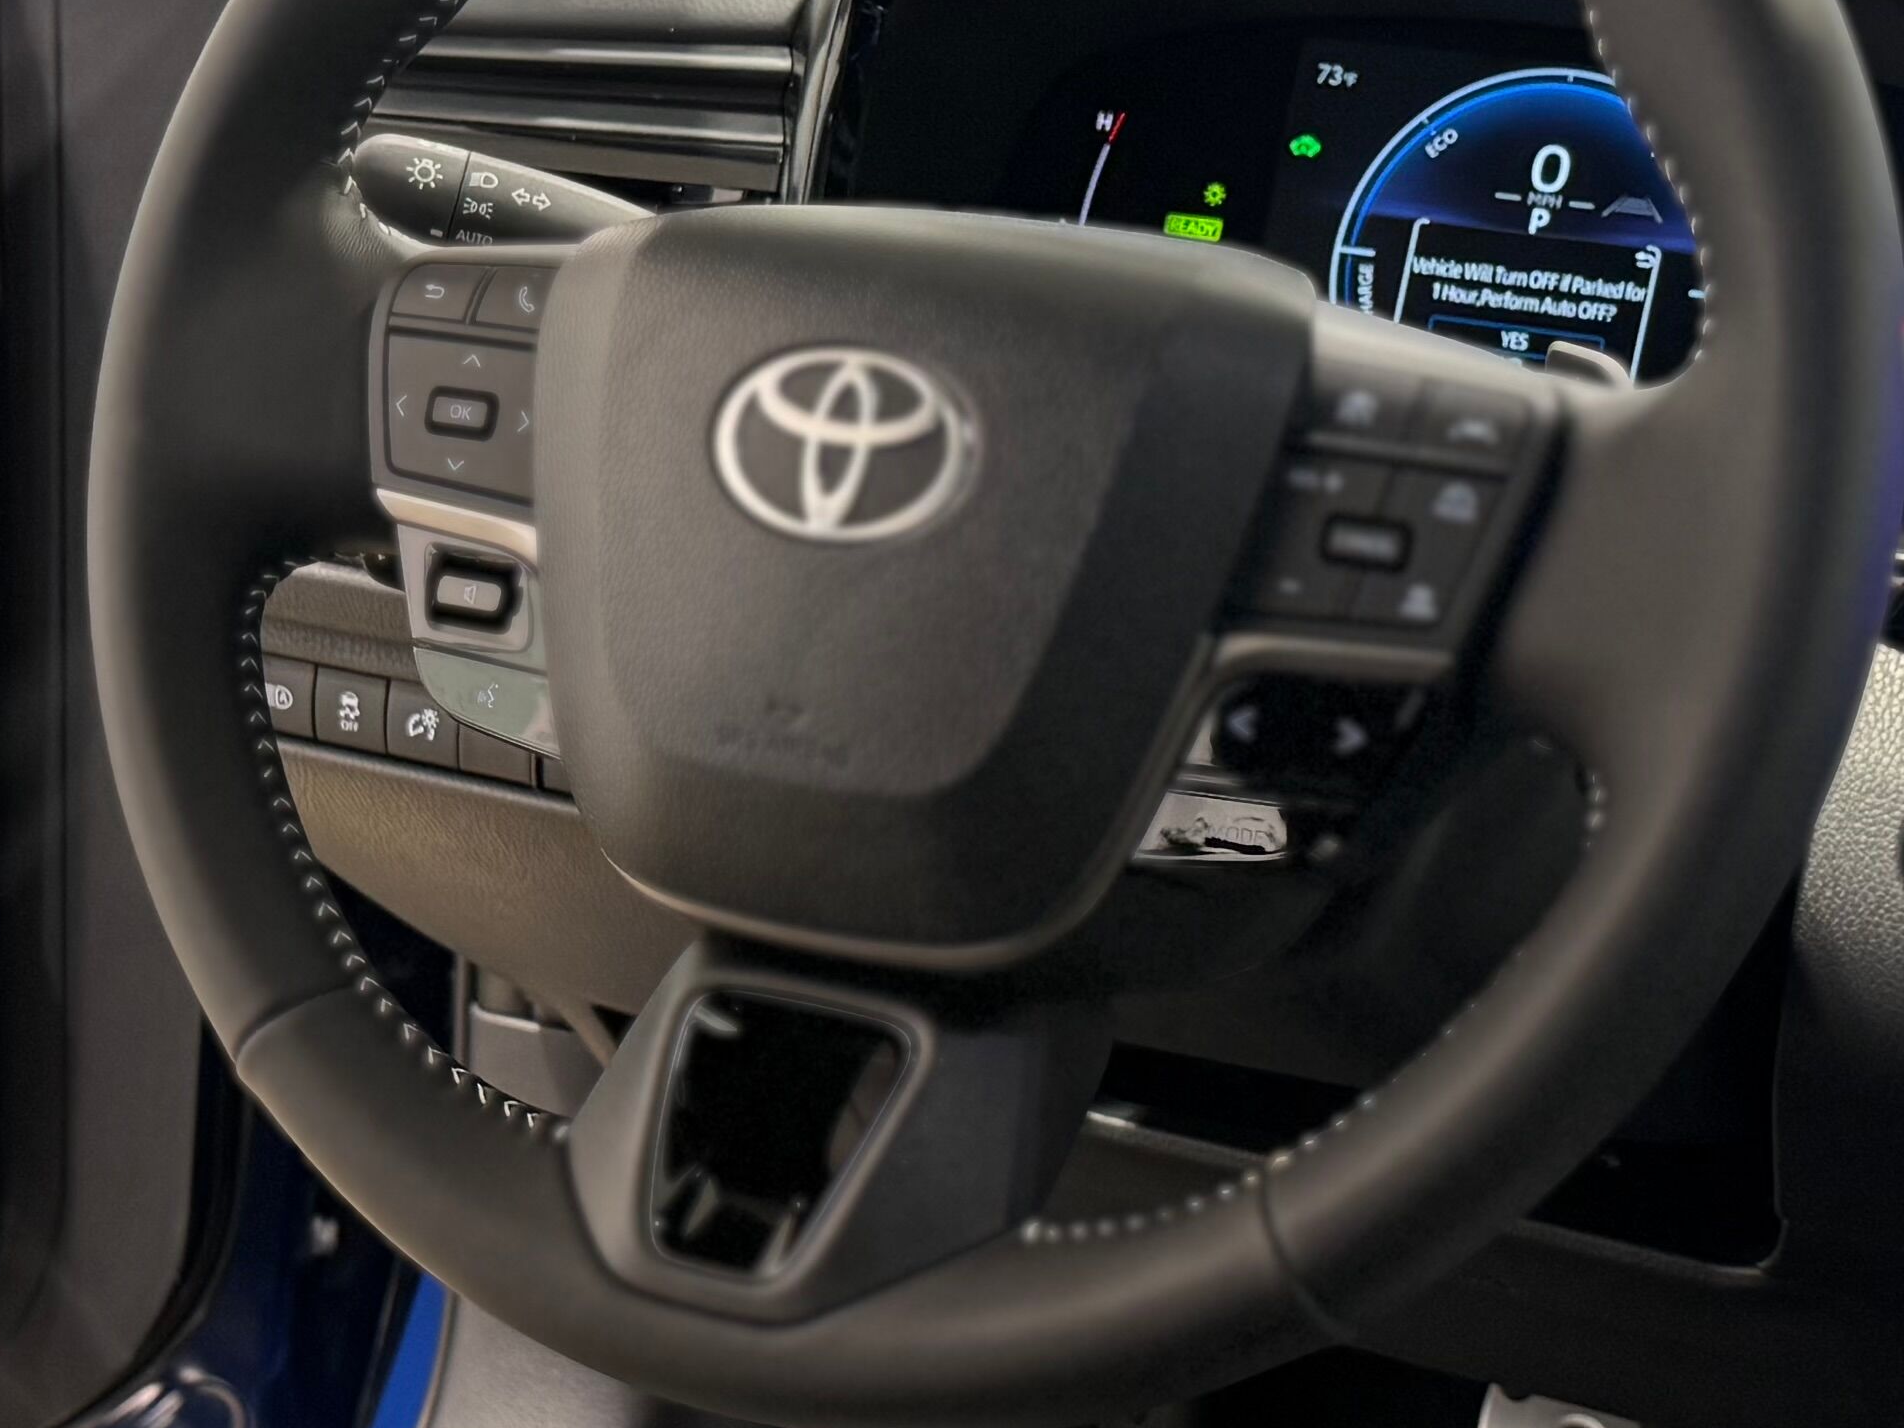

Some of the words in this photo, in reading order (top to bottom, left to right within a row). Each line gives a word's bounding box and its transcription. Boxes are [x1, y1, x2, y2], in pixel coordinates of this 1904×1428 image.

[1096, 110, 1114, 132] H
[1424, 128, 1459, 159] ECO
[1530, 144, 1571, 194] 0
[1170, 215, 1219, 239] READY
[1528, 207, 1551, 236] P
[455, 228, 494, 246] AUTO
[1412, 255, 1464, 281] Vehicle
[1464, 261, 1494, 283] Will
[1495, 266, 1528, 289] Turn
[1529, 270, 1559, 293] OFF
[1571, 273, 1624, 301] Parked
[1624, 279, 1647, 304] for
[1432, 282, 1441, 301] 1
[1542, 296, 1578, 317] Auto
[1578, 300, 1618, 323] OFF?
[1500, 330, 1530, 351] YES
[449, 404, 473, 421] OK
